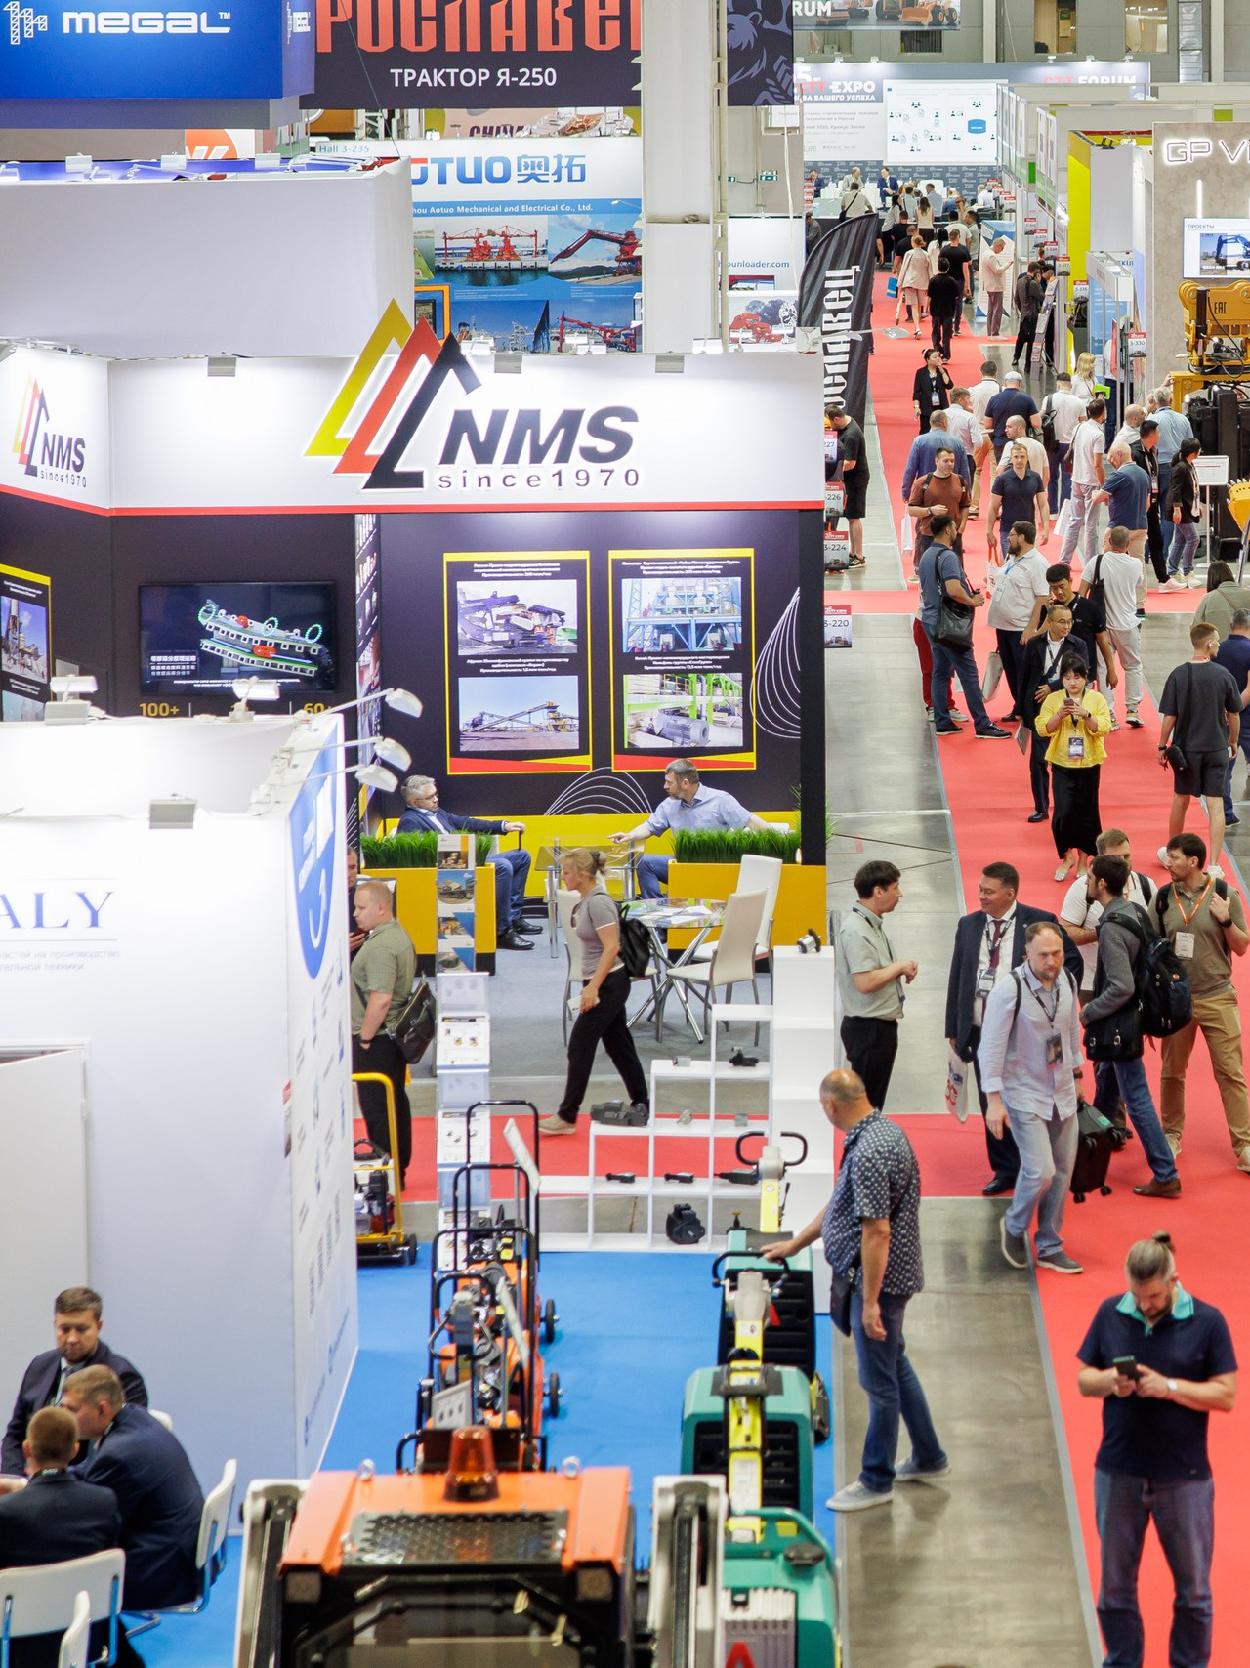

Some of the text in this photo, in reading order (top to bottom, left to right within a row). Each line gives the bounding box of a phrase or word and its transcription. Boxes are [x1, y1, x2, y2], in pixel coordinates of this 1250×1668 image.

[390, 67, 557, 87] ТРАКТОР Я-250
[1166, 141, 1211, 162] GP
[517, 153, 587, 184] 奥拓
[457, 205, 502, 214] Mechanical
[521, 204, 558, 213] Electrical
[577, 203, 594, 212] Ltd.
[438, 405, 640, 465] NMS
[40, 431, 86, 474] NMS
[40, 469, 87, 489] since1970
[438, 468, 640, 489] since1970
[139, 702, 180, 717] 100+
